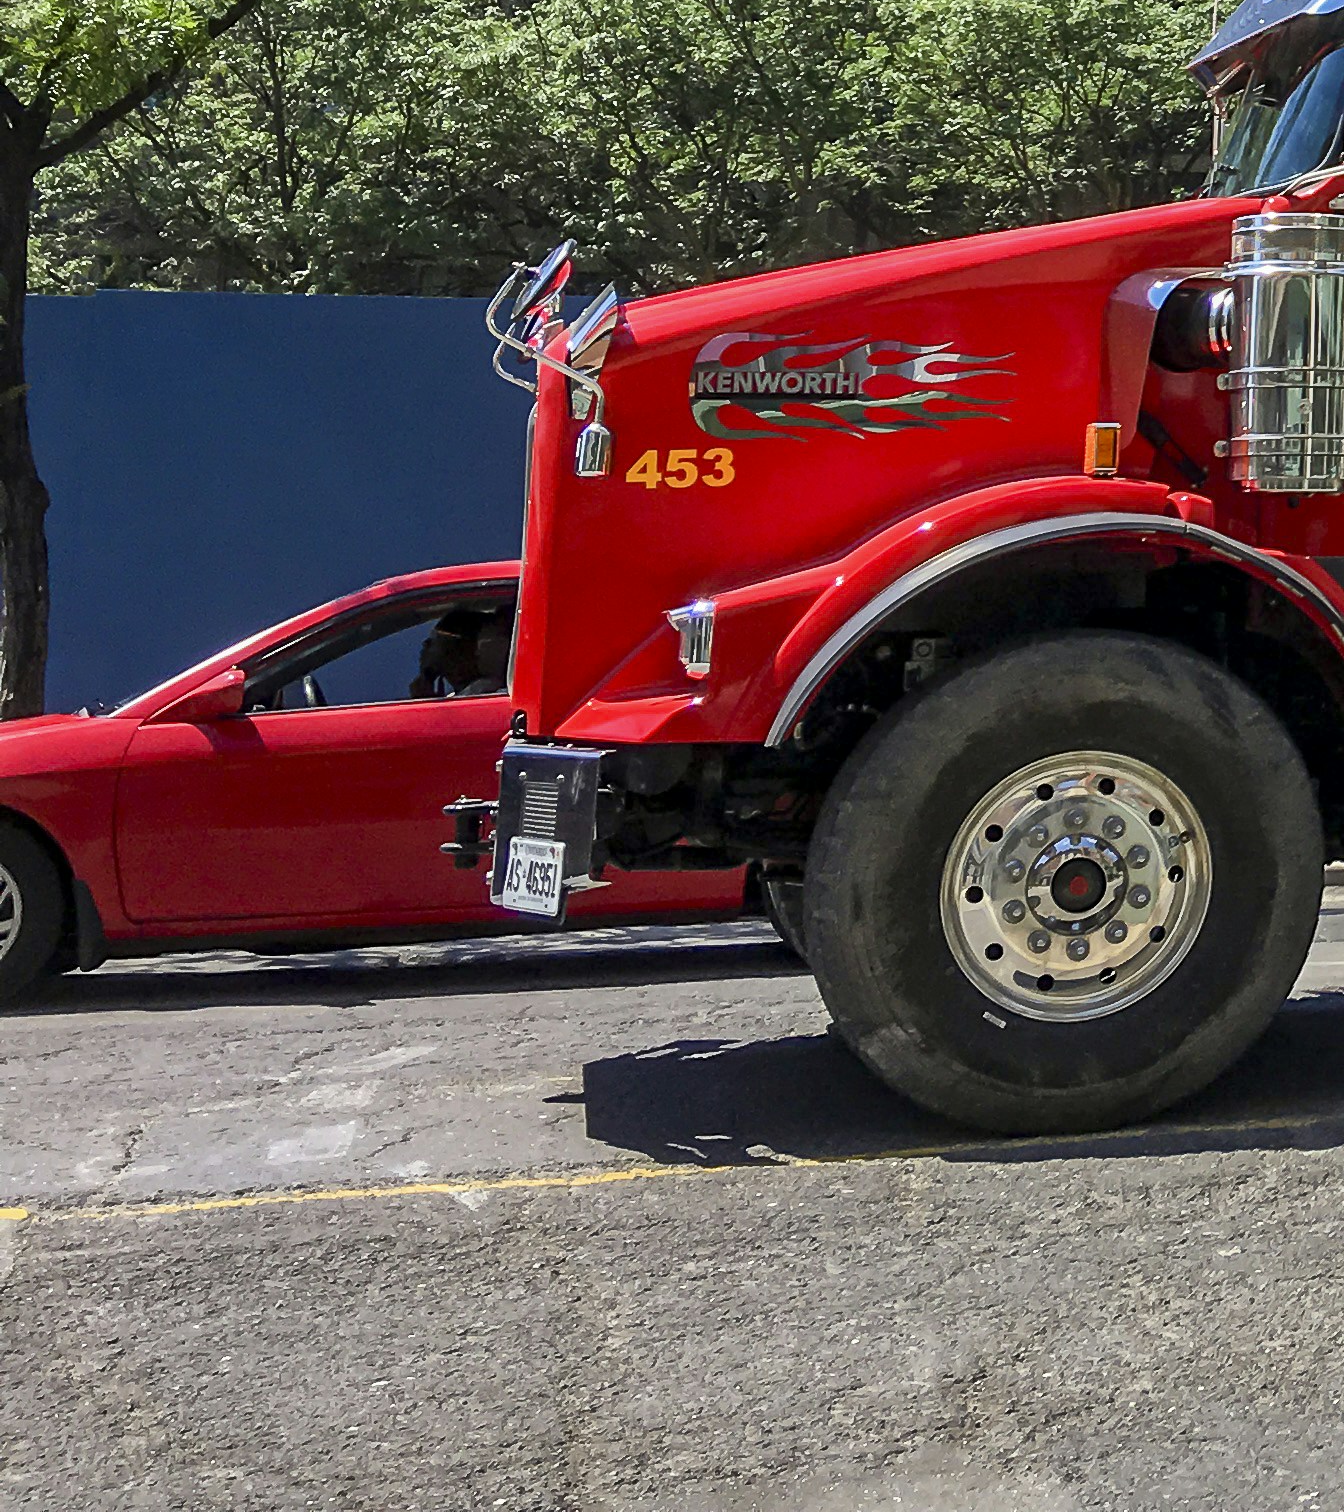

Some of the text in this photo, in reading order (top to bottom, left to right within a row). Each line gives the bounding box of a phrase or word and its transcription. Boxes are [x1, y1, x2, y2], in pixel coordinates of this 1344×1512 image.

[697, 371, 861, 395] KENWORTH
[625, 447, 736, 489] 453
[506, 857, 523, 893] AS
